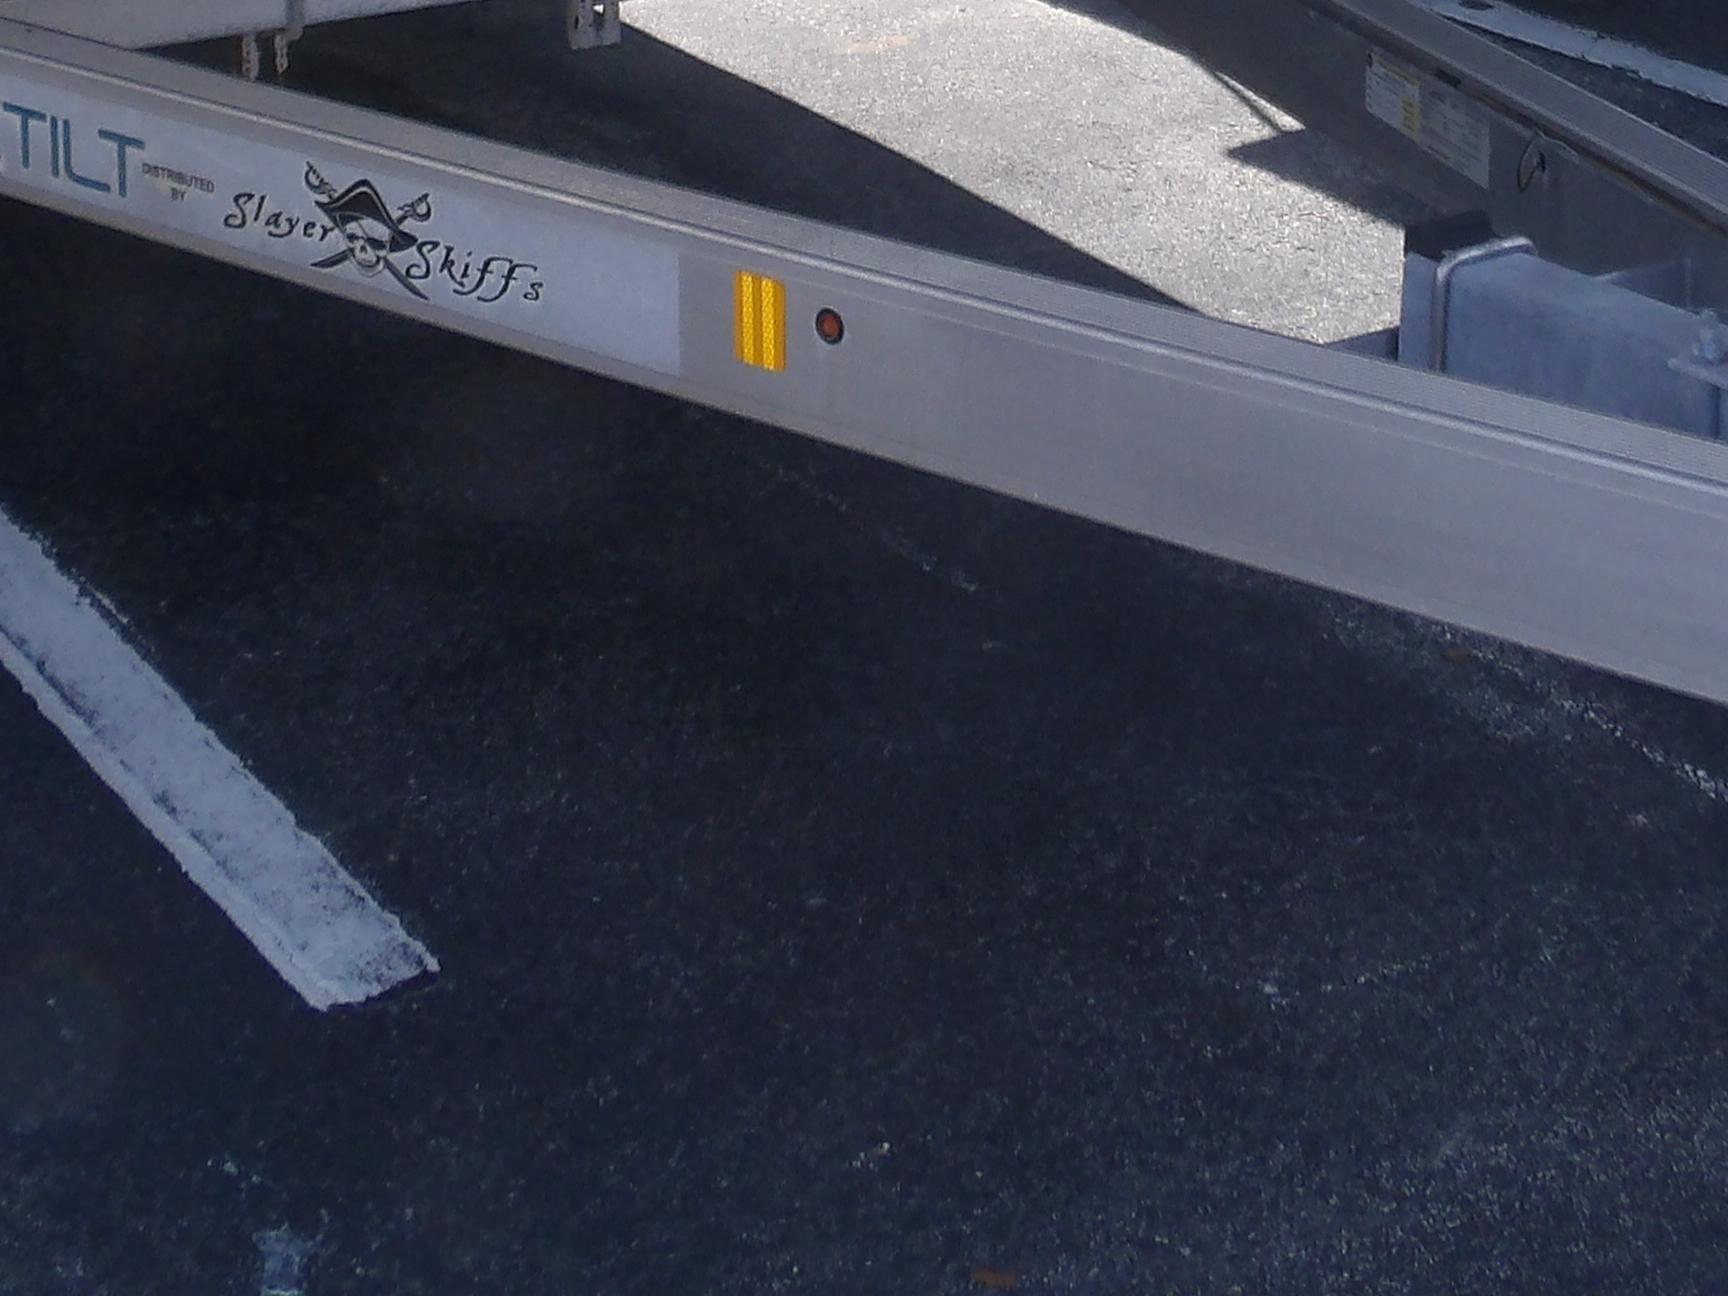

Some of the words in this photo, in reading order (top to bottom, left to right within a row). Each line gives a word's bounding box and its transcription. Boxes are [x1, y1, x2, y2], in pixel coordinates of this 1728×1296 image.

[141, 161, 216, 194] DISTRIBUTED
[170, 186, 188, 202] BY
[223, 191, 336, 243] Slayer
[404, 239, 545, 303] Skiffs
